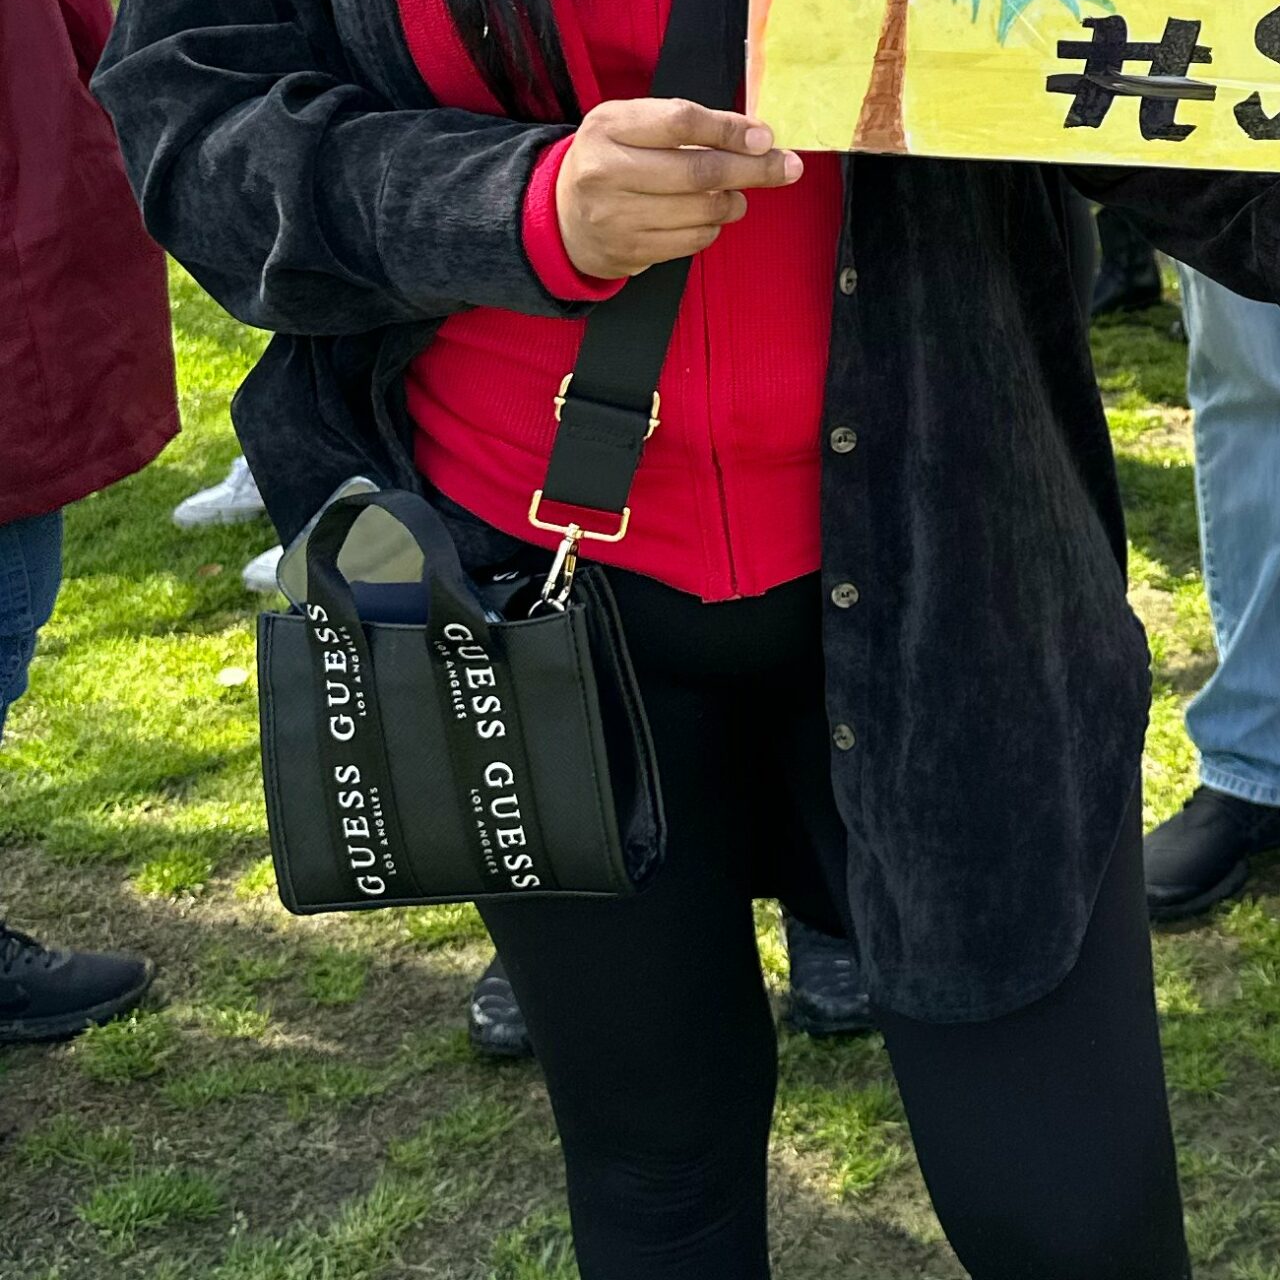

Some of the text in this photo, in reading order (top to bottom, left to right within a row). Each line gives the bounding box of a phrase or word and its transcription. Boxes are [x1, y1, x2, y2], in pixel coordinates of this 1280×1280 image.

[355, 691, 367, 717] LOS
[446, 660, 468, 720] ANGELES
[307, 603, 386, 895] GUESS GUESS
[443, 622, 541, 888] GUESS GUESS
[470, 788, 484, 813] LOS
[382, 852, 398, 876] LOS
